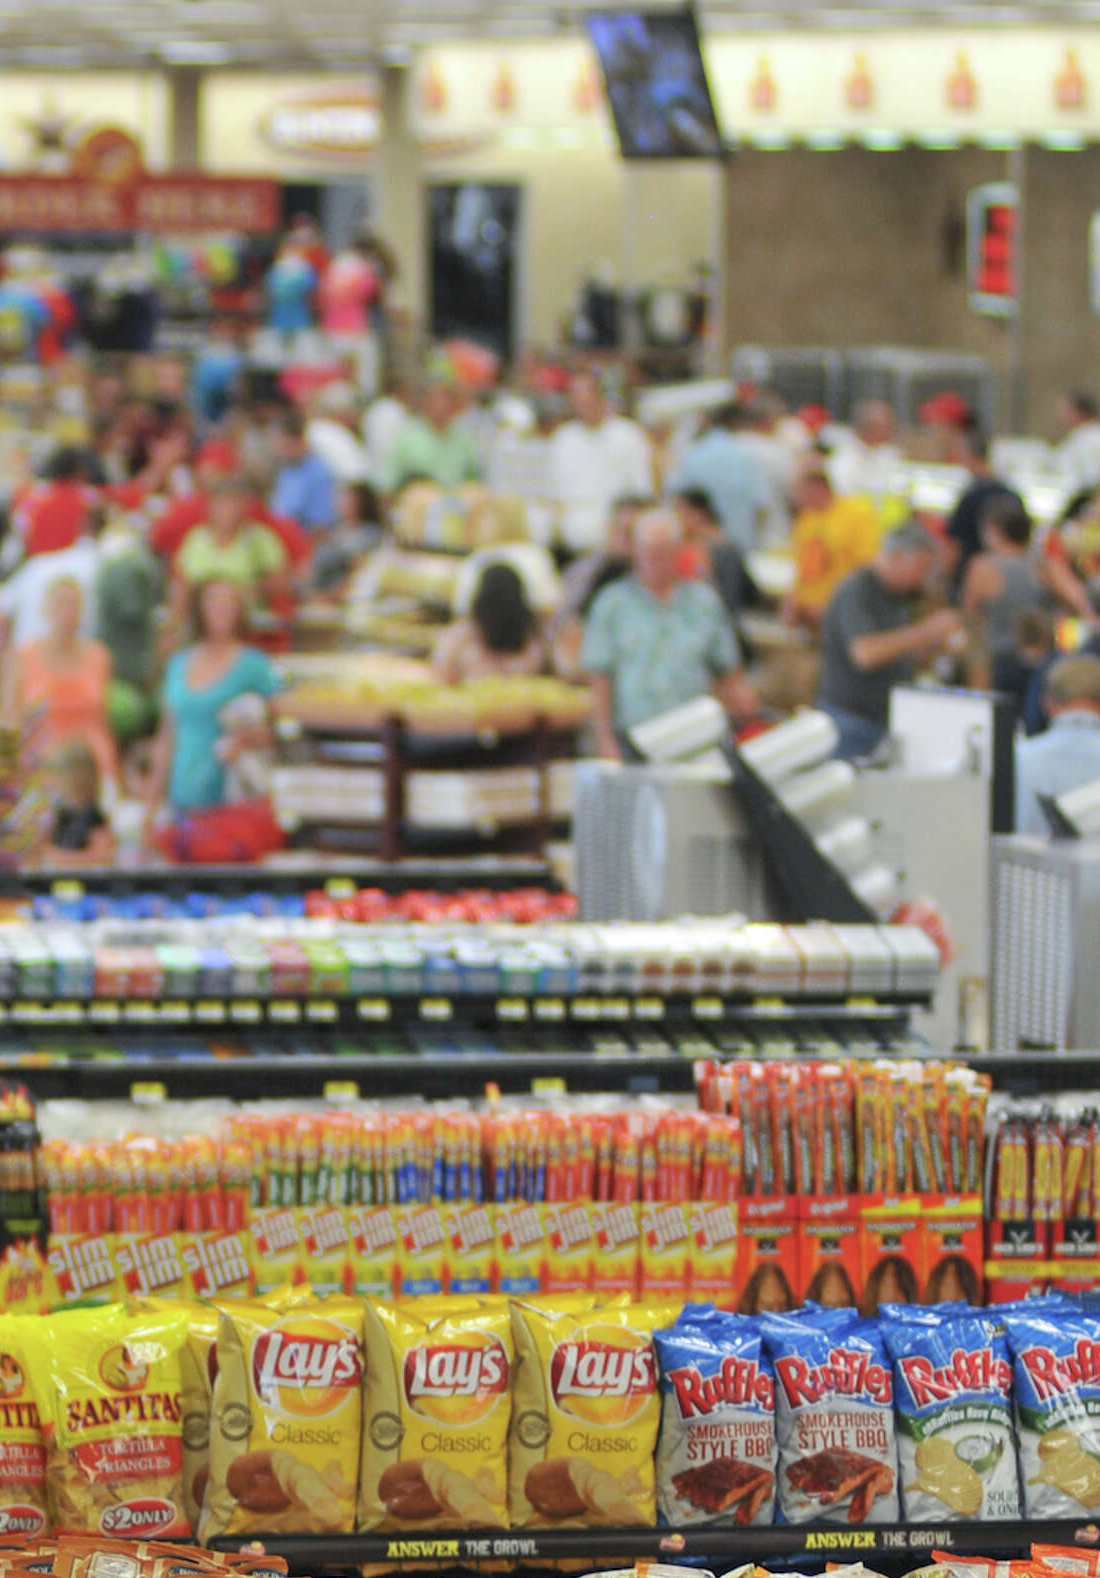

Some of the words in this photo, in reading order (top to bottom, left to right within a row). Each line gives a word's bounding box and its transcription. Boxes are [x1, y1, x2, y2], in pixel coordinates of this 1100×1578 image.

[261, 1332, 358, 1388] Lay's
[410, 1344, 504, 1398] Lay's
[556, 1344, 653, 1398] Lay's
[1019, 1337, 1100, 1405] Ruff
[669, 1356, 775, 1419] Ruffles
[775, 1348, 892, 1409] Ruffles
[66, 1393, 182, 1432] SANTITAS
[796, 1411, 885, 1428] SMOKEHOUSE
[271, 1423, 341, 1445] Classic
[421, 1431, 492, 1453] Classic
[568, 1431, 639, 1453] Classic
[686, 1422, 773, 1440] SMOKEHOUSE
[798, 1429, 849, 1450] STYLE
[856, 1428, 888, 1449] BBQ
[99, 1439, 166, 1456] TORTILLA
[686, 1440, 739, 1461] STYLE
[96, 1456, 171, 1473] TRIANGLES
[9, 1517, 42, 1532] ONLY
[103, 1507, 132, 1530] $2
[130, 1508, 174, 1526] ONLY
[387, 1540, 460, 1559] ANSWER
[465, 1539, 490, 1556] THE
[492, 1538, 539, 1555] GROWL
[805, 1531, 877, 1549] ANSWER
[881, 1531, 906, 1548] THE
[909, 1530, 955, 1547] GROWL
